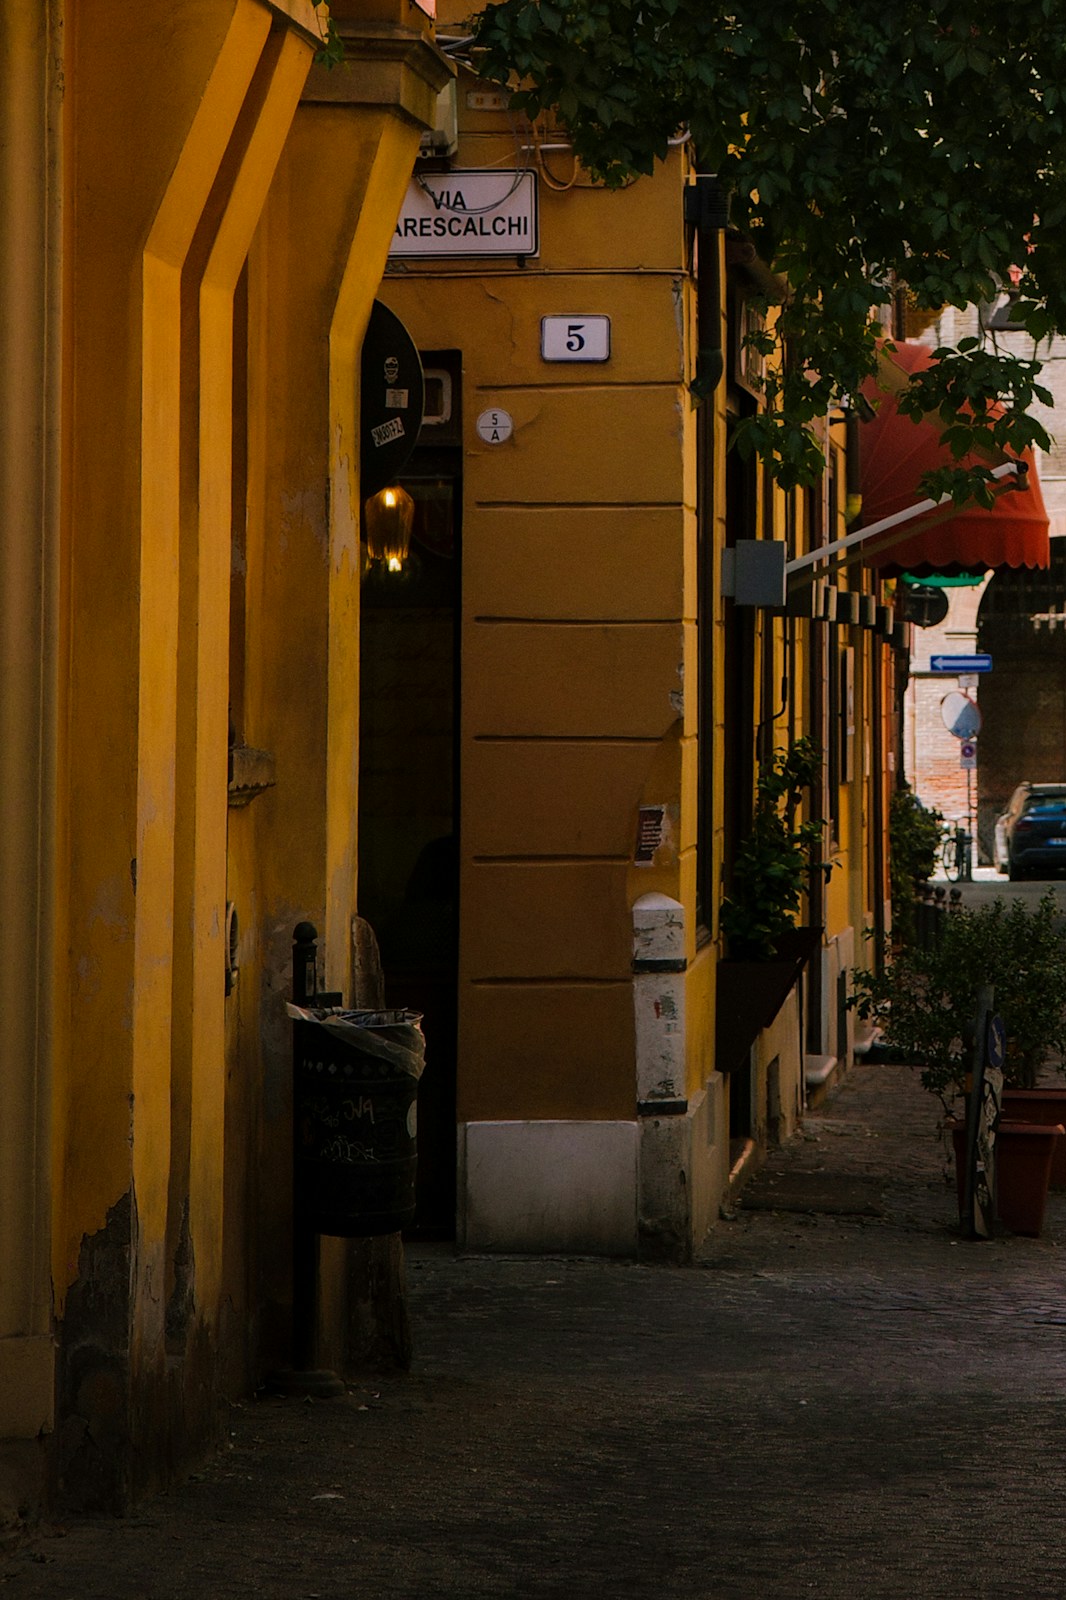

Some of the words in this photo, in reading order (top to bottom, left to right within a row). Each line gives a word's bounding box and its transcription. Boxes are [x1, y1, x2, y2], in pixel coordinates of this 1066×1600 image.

[431, 190, 466, 210] VIA
[566, 325, 585, 352] 5
[492, 413, 498, 426] 5
[491, 429, 500, 441] A
